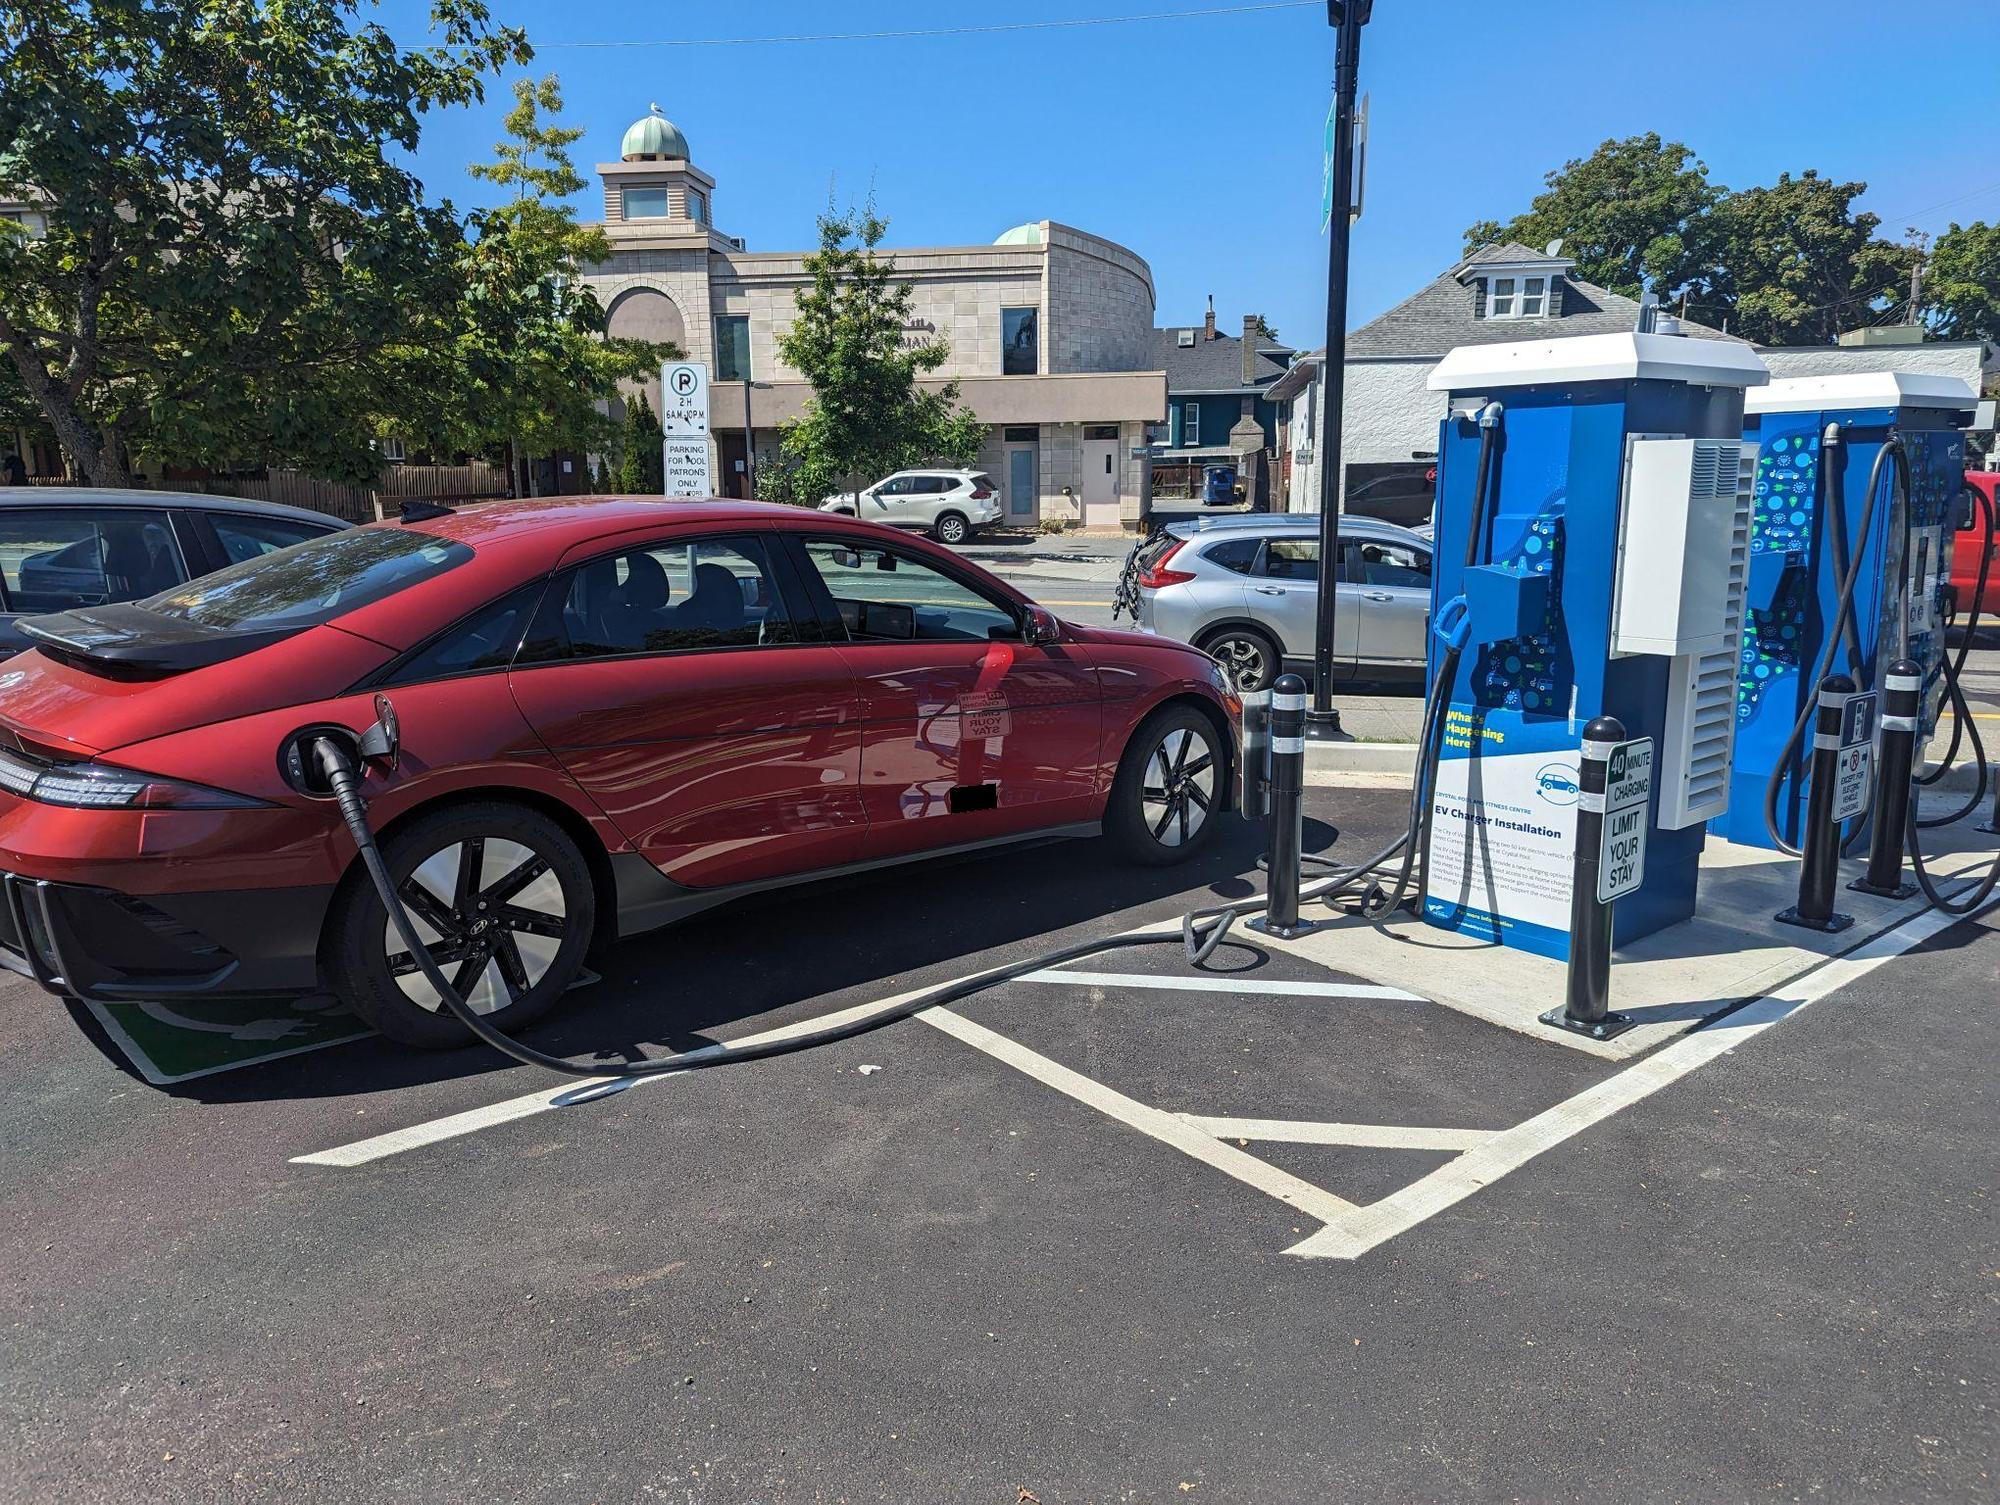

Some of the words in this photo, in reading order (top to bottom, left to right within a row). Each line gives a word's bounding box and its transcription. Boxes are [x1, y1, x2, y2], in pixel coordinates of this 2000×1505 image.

[679, 373, 691, 391] P
[680, 398, 685, 406] 2
[687, 398, 692, 406] H
[669, 446, 704, 454] PARKING
[686, 457, 706, 465] POOL
[669, 468, 706, 476] PATRONS
[677, 480, 698, 488] ONLY
[1446, 710, 1485, 725] What's
[1446, 722, 1505, 743] Happening
[1445, 735, 1476, 749] Here?
[1611, 754, 1625, 775] 40
[1626, 752, 1650, 771] MINUTE
[1841, 774, 1856, 785] EXCEPT
[1856, 771, 1864, 780] FOR
[1614, 778, 1649, 801] CHARGING
[1842, 792, 1858, 803] VEHICLE
[1435, 791, 1457, 801] CRYSTAL
[1485, 801, 1508, 810] FITNESS
[1508, 806, 1532, 815] CENTRE
[1435, 804, 1448, 815] EV
[1450, 808, 1492, 826] Charger
[1495, 817, 1561, 839] Installation
[1612, 811, 1640, 838] LIMIT
[1610, 837, 1638, 863] YOUR
[1609, 862, 1635, 888] STAY
